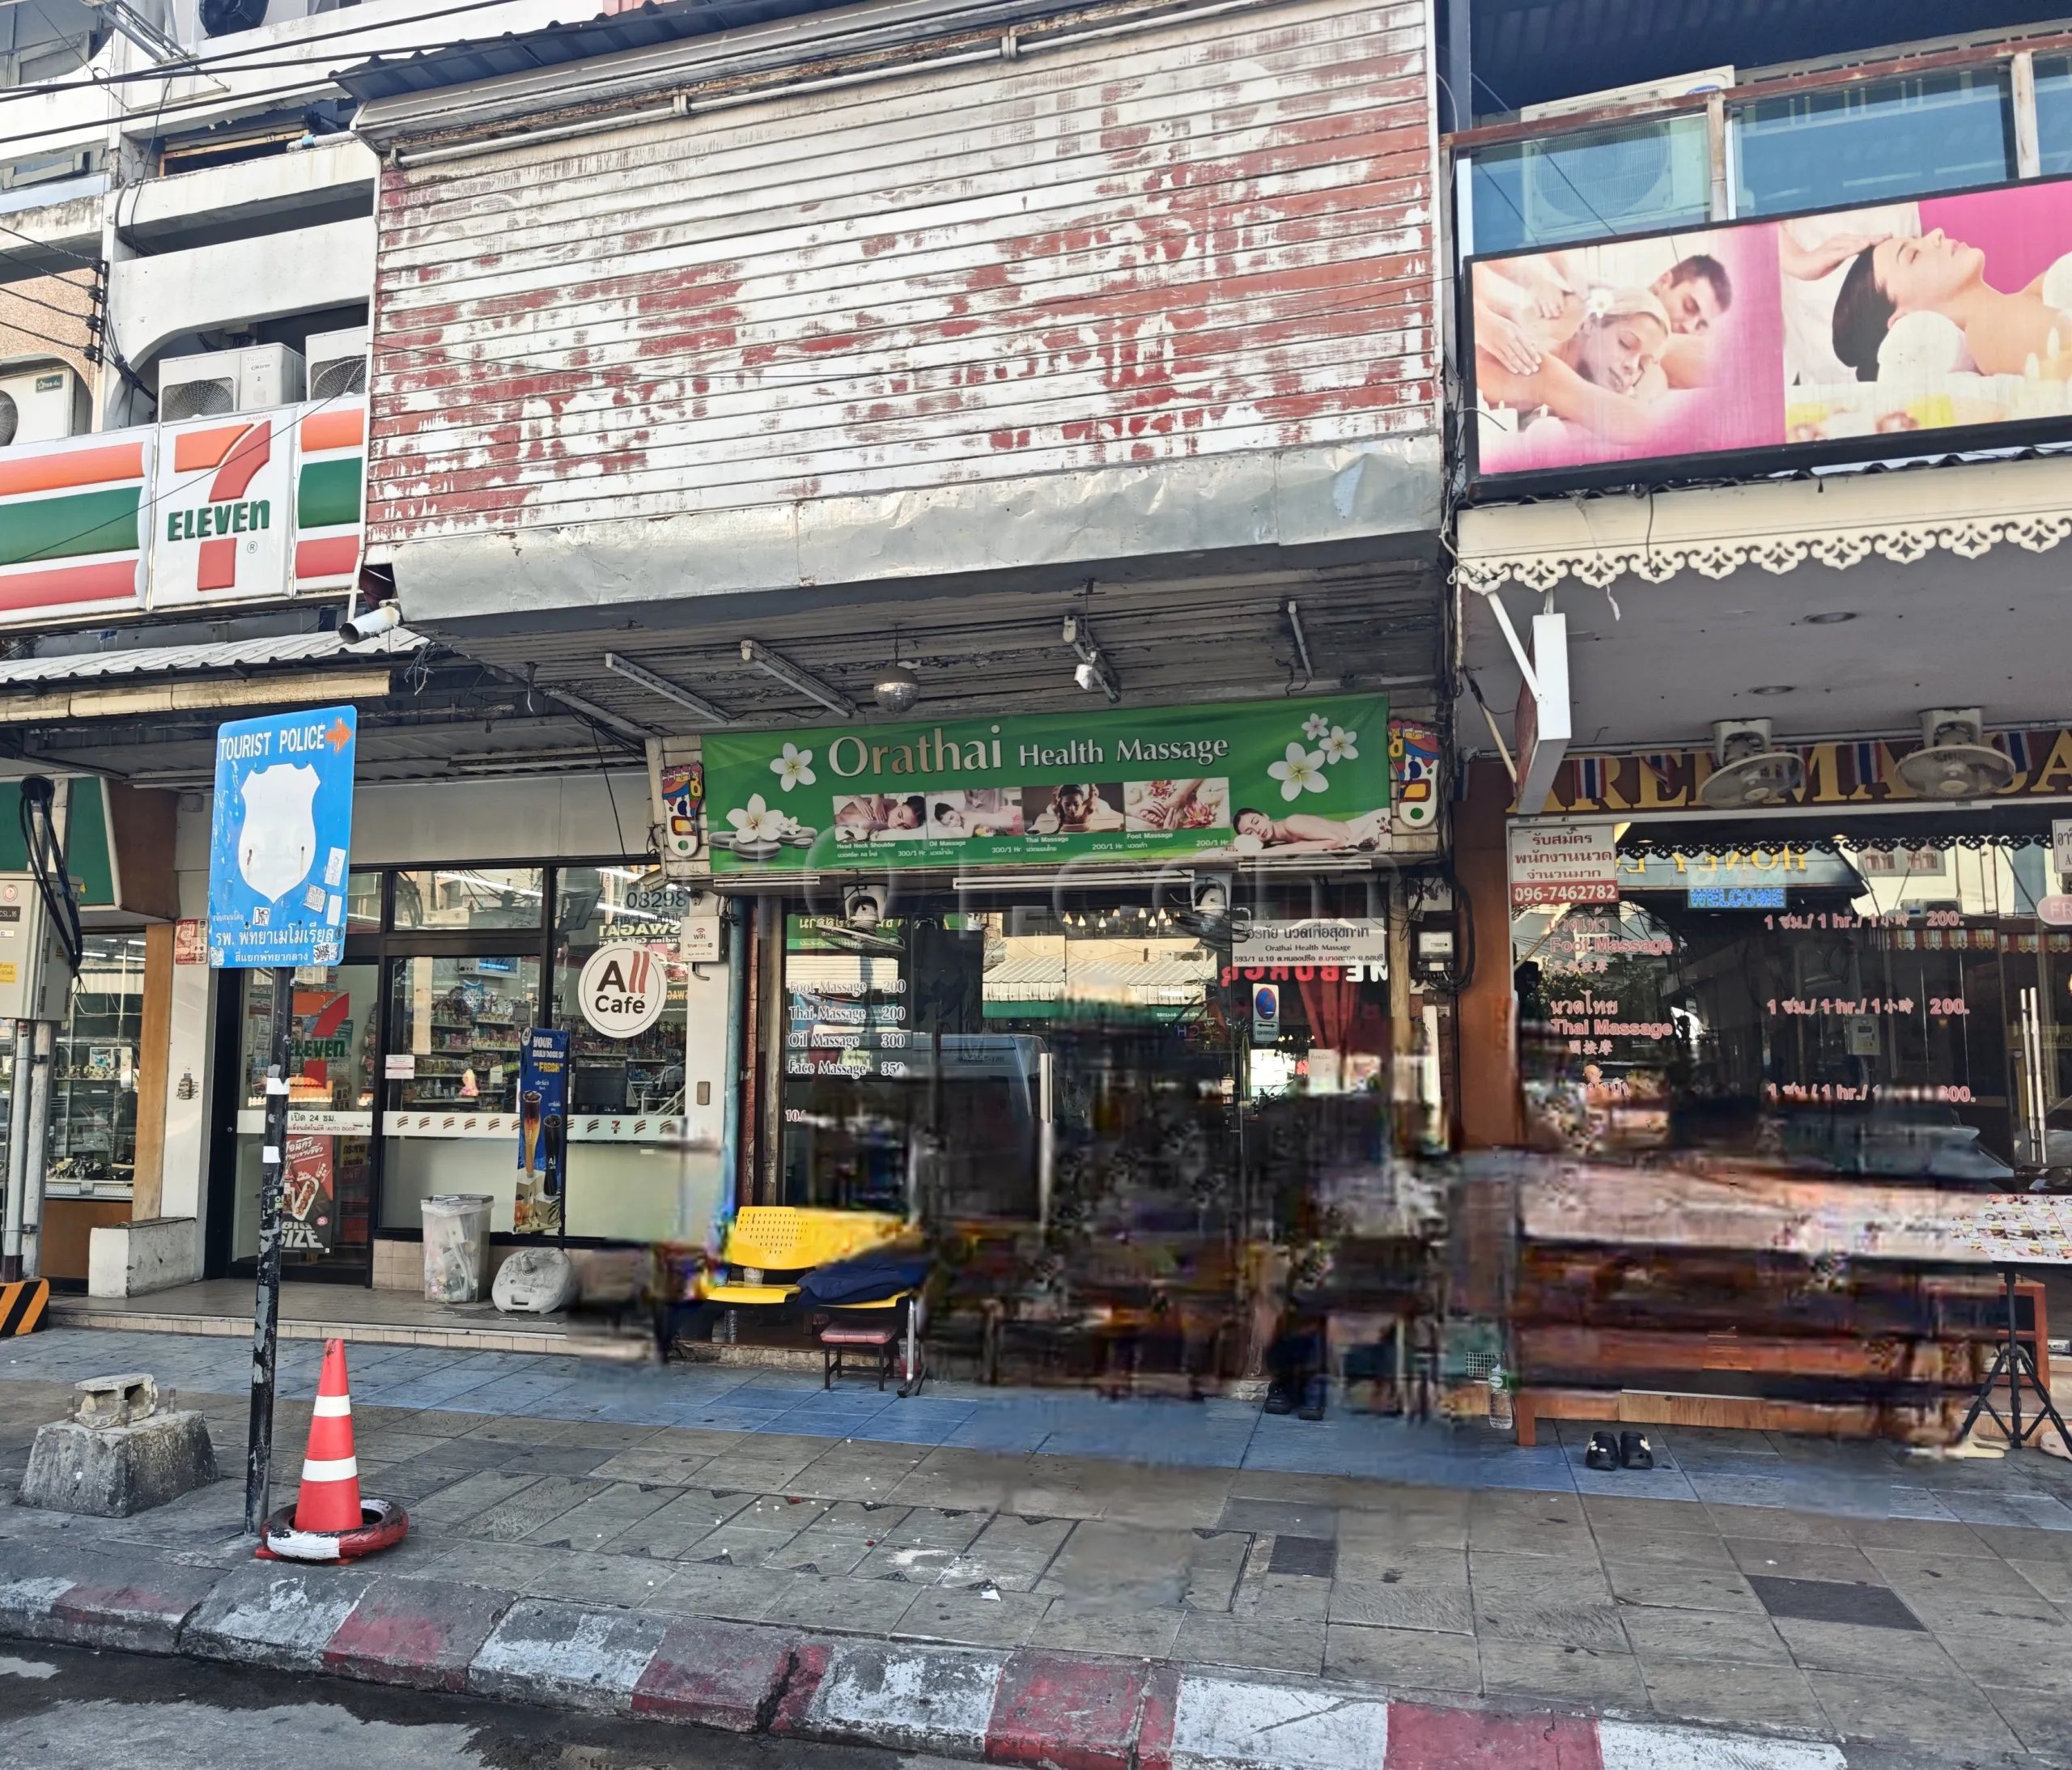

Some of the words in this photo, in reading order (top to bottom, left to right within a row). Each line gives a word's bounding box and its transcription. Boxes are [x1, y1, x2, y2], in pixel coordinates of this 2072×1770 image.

[175, 420, 271, 591] 7
[219, 732, 271, 761] TOURIST
[279, 724, 325, 753] POLICE
[829, 725, 1001, 777] Orathai
[1020, 738, 1104, 767] Health
[1117, 737, 1229, 767] Massage
[1041, 835, 1069, 843] Massage
[1092, 843, 1114, 851] 200/1
[1196, 839, 1219, 847] 200/1
[1515, 849, 1611, 864] พนักงานนวด
[1526, 868, 1601, 880] จำนวนมาก
[1514, 885, 1616, 902] 096-7462782
[1689, 887, 1785, 907] WELCOME
[215, 932, 235, 945] รพ.
[239, 922, 334, 945] พัทยาเมโมเรียล
[1265, 944, 1293, 952] Orathai
[1295, 944, 1319, 952] Health
[1322, 944, 1352, 953] Massage
[1550, 937, 1590, 953] Foot
[1594, 936, 1673, 956] Massage
[1233, 954, 1255, 962] 593/1
[597, 951, 650, 994] All
[789, 980, 816, 994] Foot
[819, 980, 868, 997] Massage
[881, 979, 907, 994] 200
[595, 995, 645, 1014] Café
[1550, 989, 1618, 1015] นวดไทย
[788, 1005, 815, 1021] Thai
[817, 1006, 867, 1025] Massage
[881, 1005, 906, 1021] 200
[1550, 1019, 1589, 1035] Thai
[1594, 1019, 1673, 1040] Massage
[533, 1036, 553, 1049] YOUR
[788, 1034, 807, 1048] Oil
[810, 1034, 860, 1051] Massage
[881, 1034, 906, 1048] 300
[788, 1060, 815, 1075] Face
[817, 1061, 868, 1080] Massage
[291, 1111, 306, 1123] เปิด
[309, 1114, 319, 1122] 24
[282, 1221, 312, 1230] BIG
